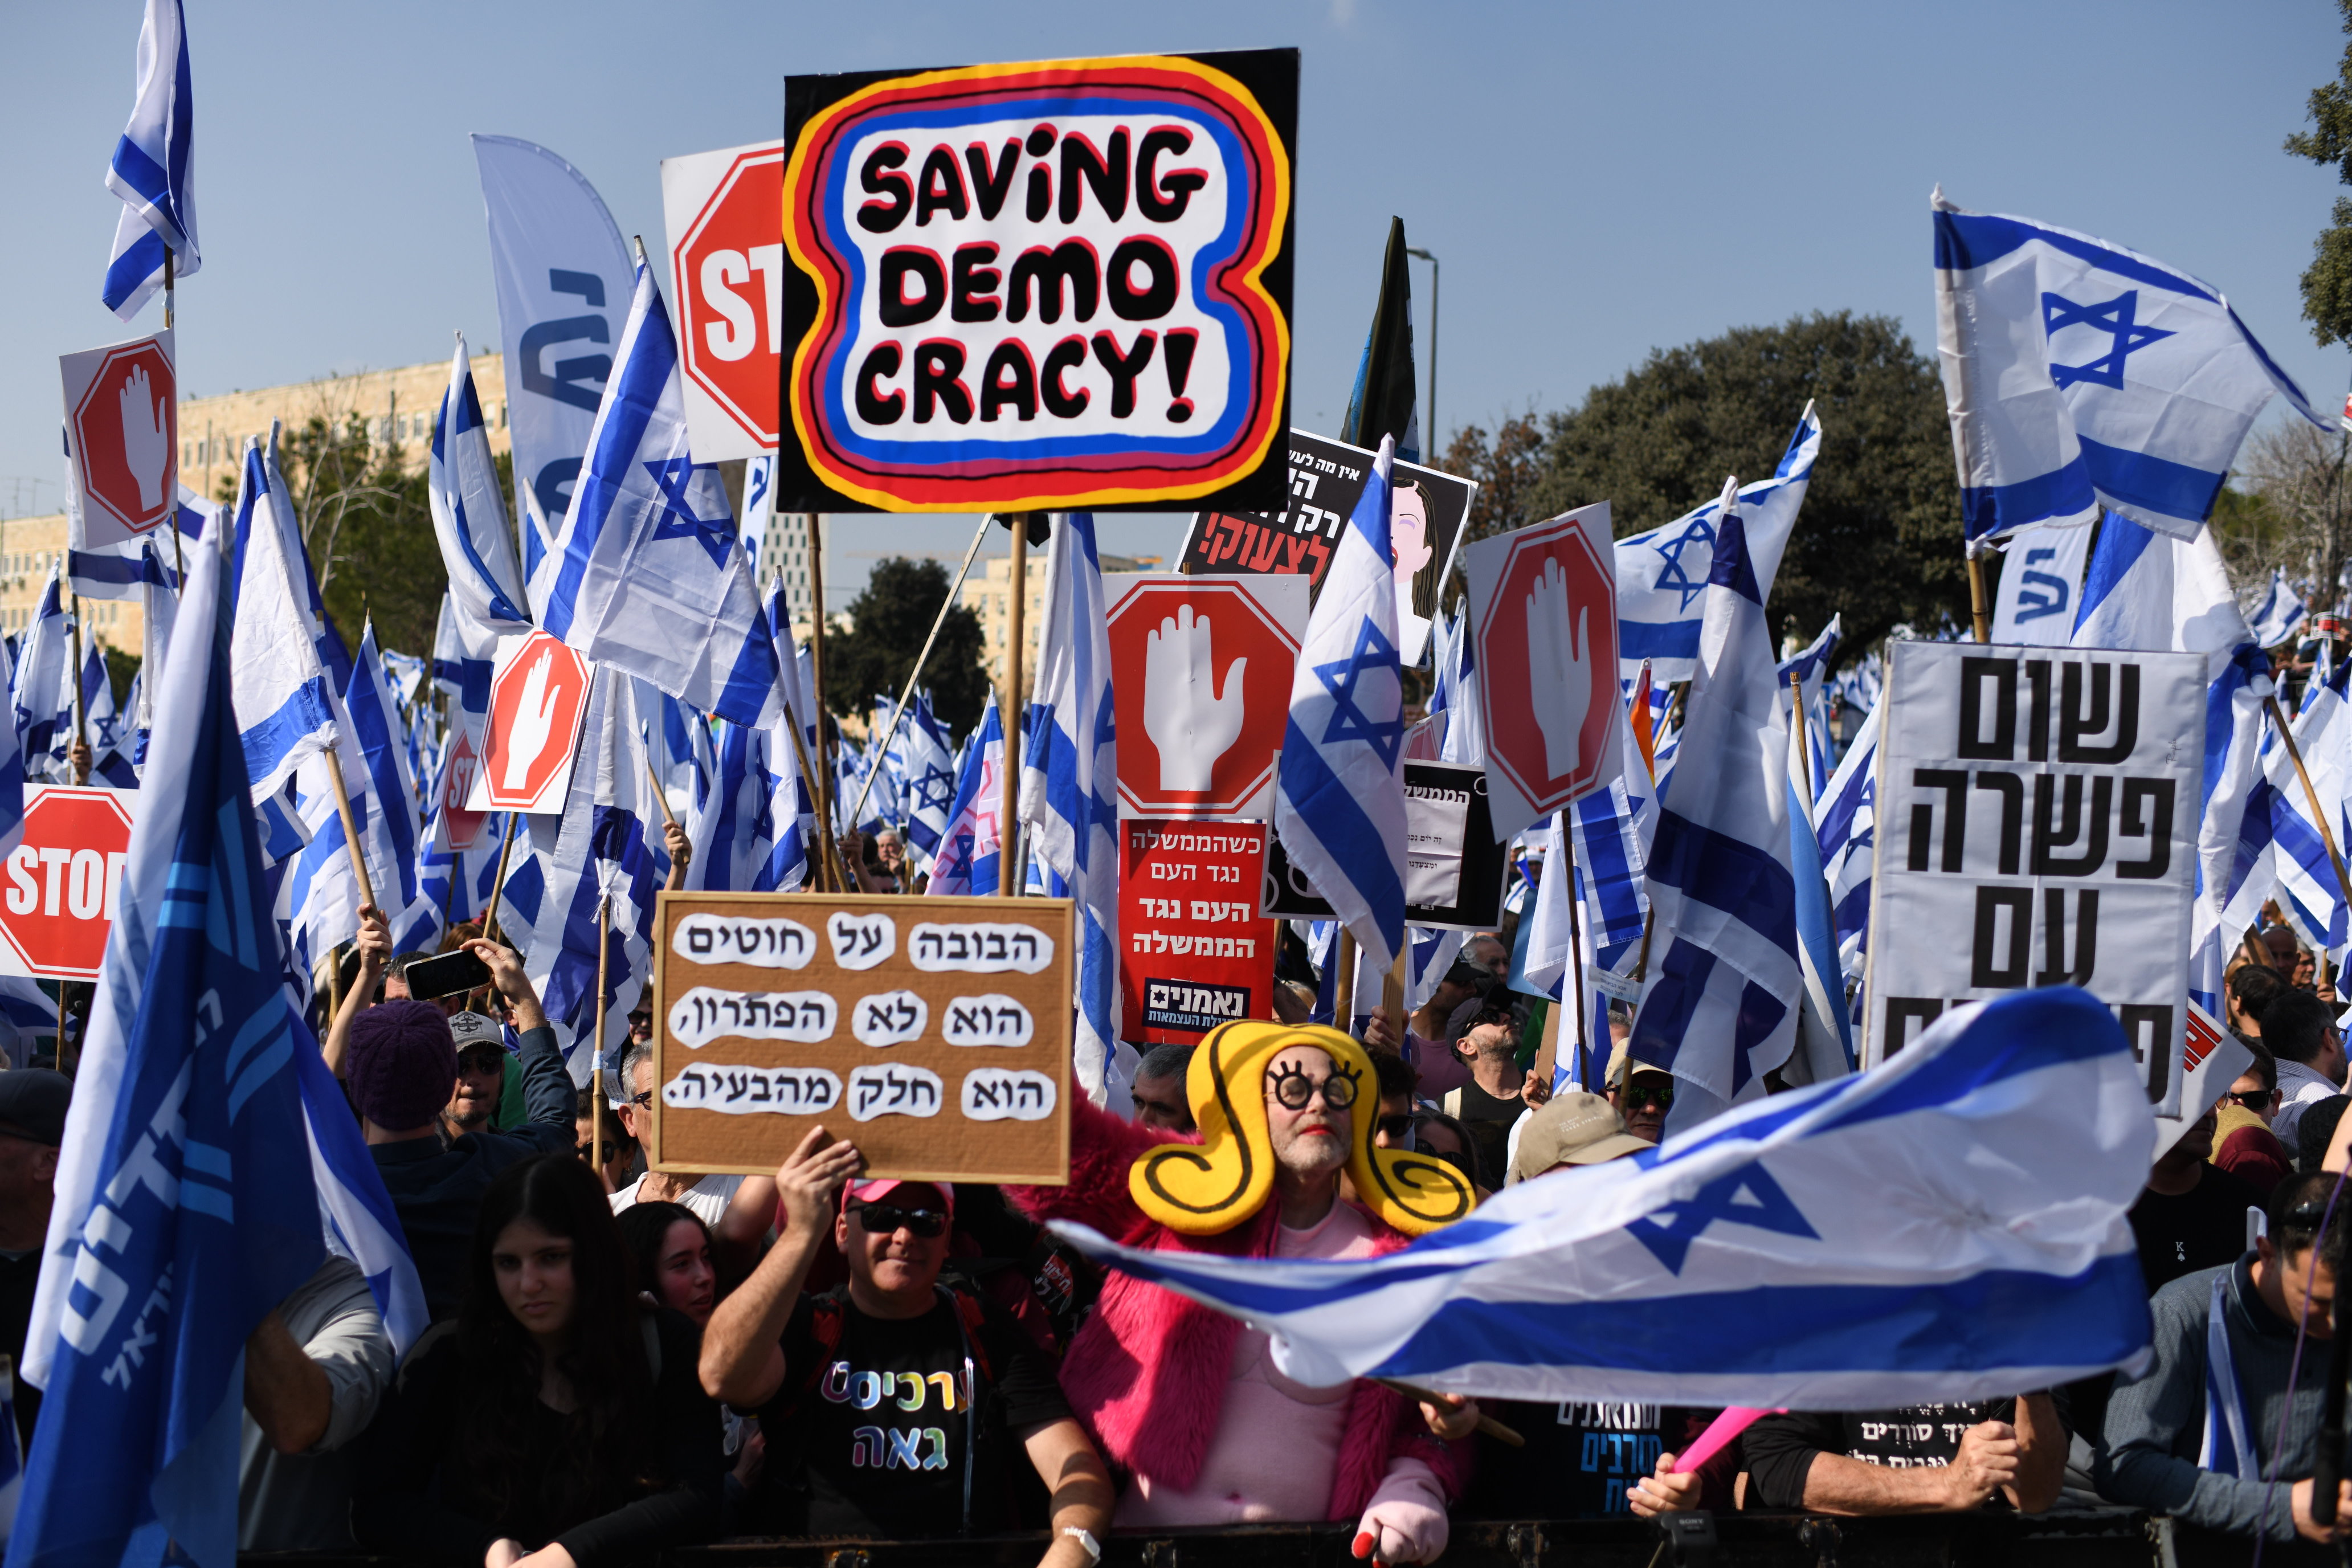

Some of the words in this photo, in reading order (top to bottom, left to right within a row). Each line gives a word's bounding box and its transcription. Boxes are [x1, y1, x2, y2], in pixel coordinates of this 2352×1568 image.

[878, 234, 1180, 328] DEMO
[700, 243, 783, 362] ST
[855, 326, 1199, 426] CRACY!
[1289, 450, 1314, 467] לעש
[1315, 458, 1337, 474] מה
[1338, 464, 1361, 481] אין
[1293, 504, 1341, 540] רק
[1198, 512, 1330, 587] לצעוק!
[1958, 656, 2141, 765] שום
[1907, 767, 2177, 880] פשרה
[1132, 829, 1261, 855] כשהממשלה
[1150, 862, 1197, 881] העם
[1206, 865, 1240, 883] נגד
[1138, 897, 1181, 920] נגד
[1190, 900, 1251, 922] העם
[687, 924, 805, 954] חוטים
[836, 920, 883, 956] על
[917, 930, 1037, 961] הבובה
[1133, 929, 1255, 958] הממשלה
[1970, 885, 2100, 990] עם
[678, 995, 826, 1035] הפתרון,
[867, 996, 917, 1032] לא
[1149, 984, 1244, 1016] נאמנים
[953, 1004, 1023, 1036] הוא
[1148, 1010, 1199, 1026] העצמאות
[668, 1071, 831, 1104] מהבעיה.
[856, 1070, 936, 1113] חלק
[973, 1079, 1044, 1109] הוא
[2175, 1242, 2184, 1252] K
[852, 1426, 948, 1470] גאה
